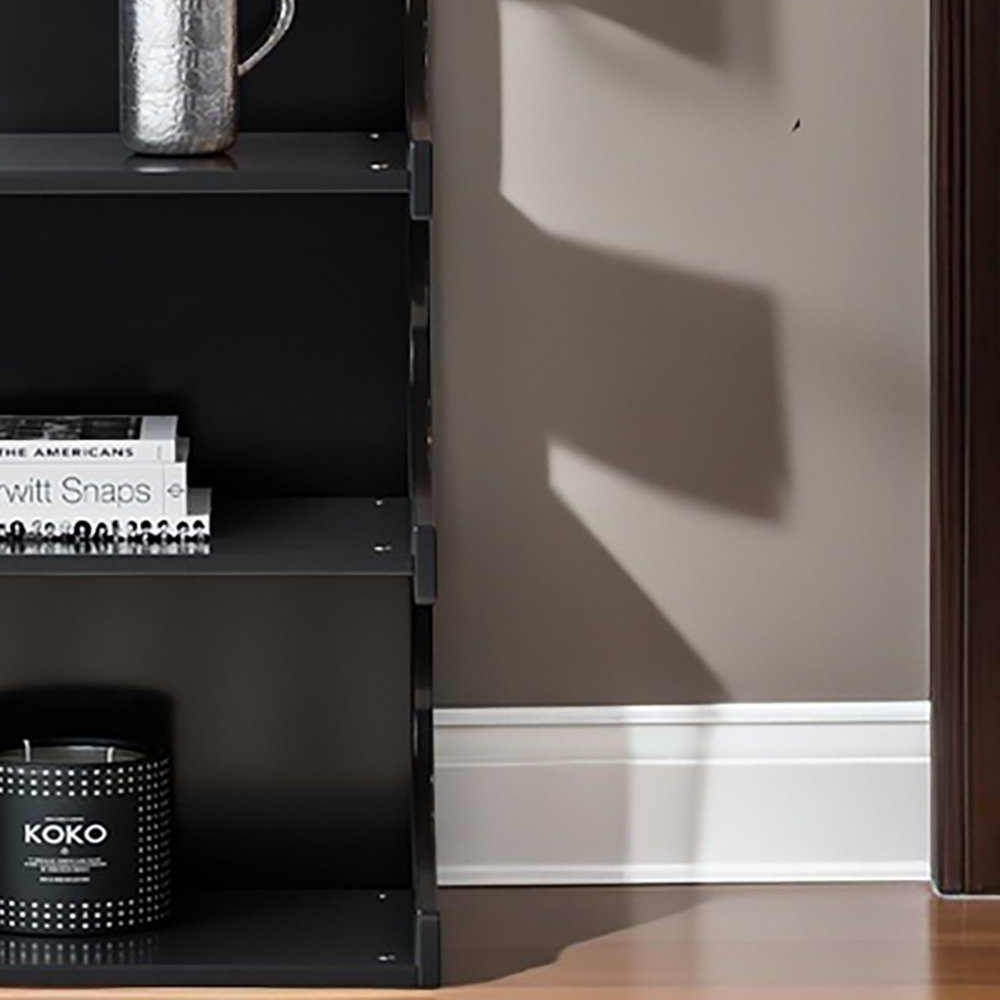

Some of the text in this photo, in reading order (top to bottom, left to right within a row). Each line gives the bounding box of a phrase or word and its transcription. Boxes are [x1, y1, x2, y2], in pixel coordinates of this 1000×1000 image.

[33, 447, 135, 458] AMERICANS
[61, 476, 151, 508] Snaps
[24, 824, 108, 844] KOKO
